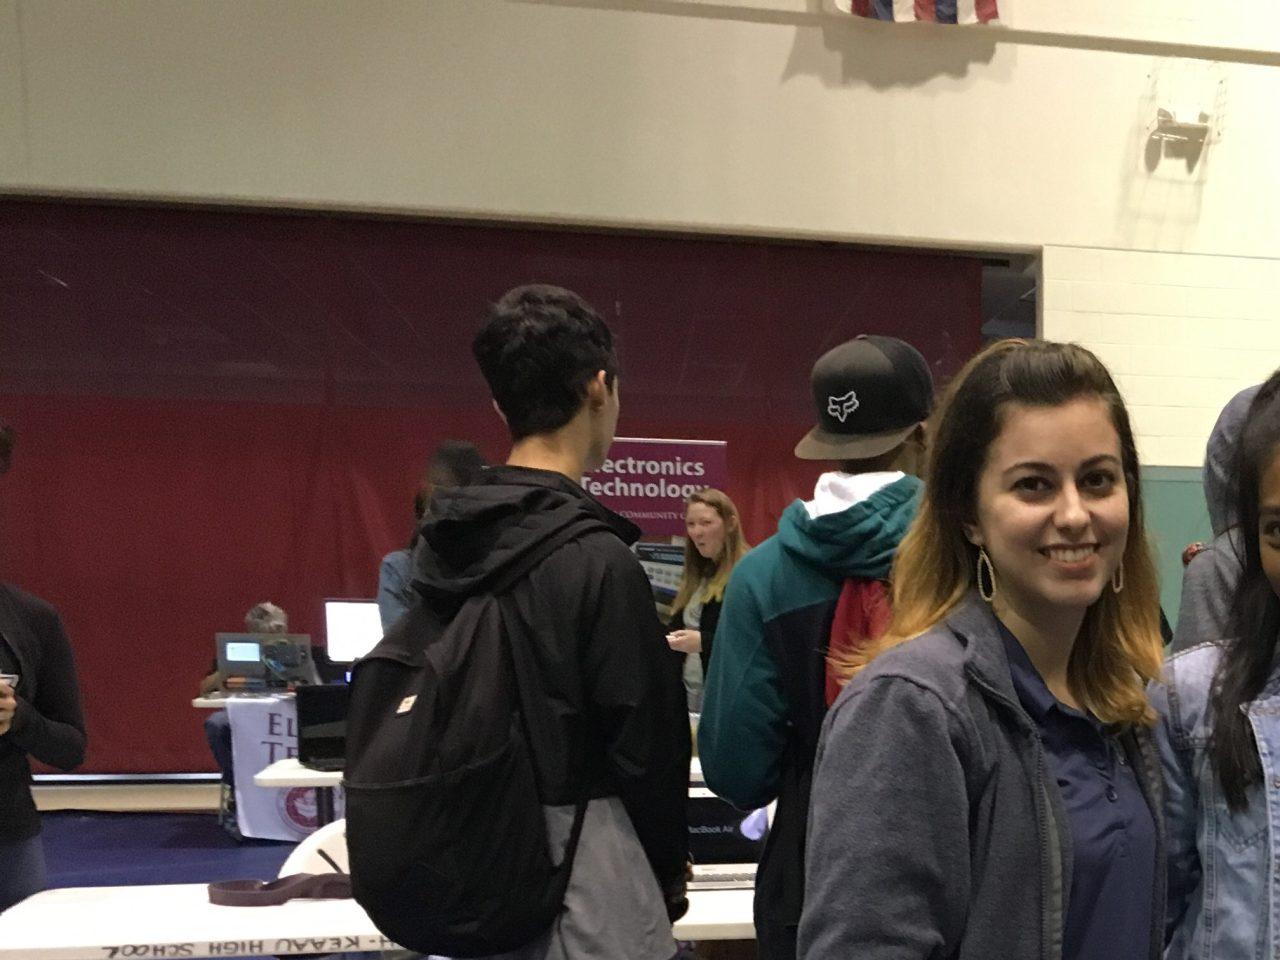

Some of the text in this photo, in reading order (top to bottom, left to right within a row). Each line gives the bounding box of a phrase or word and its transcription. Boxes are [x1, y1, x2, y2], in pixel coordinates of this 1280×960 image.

[594, 456, 705, 476] ectronics
[580, 476, 709, 503] Technolog
[101, 942, 194, 960] SCHOOL
[208, 939, 264, 954] HIGH
[275, 935, 361, 951] KEAAU
